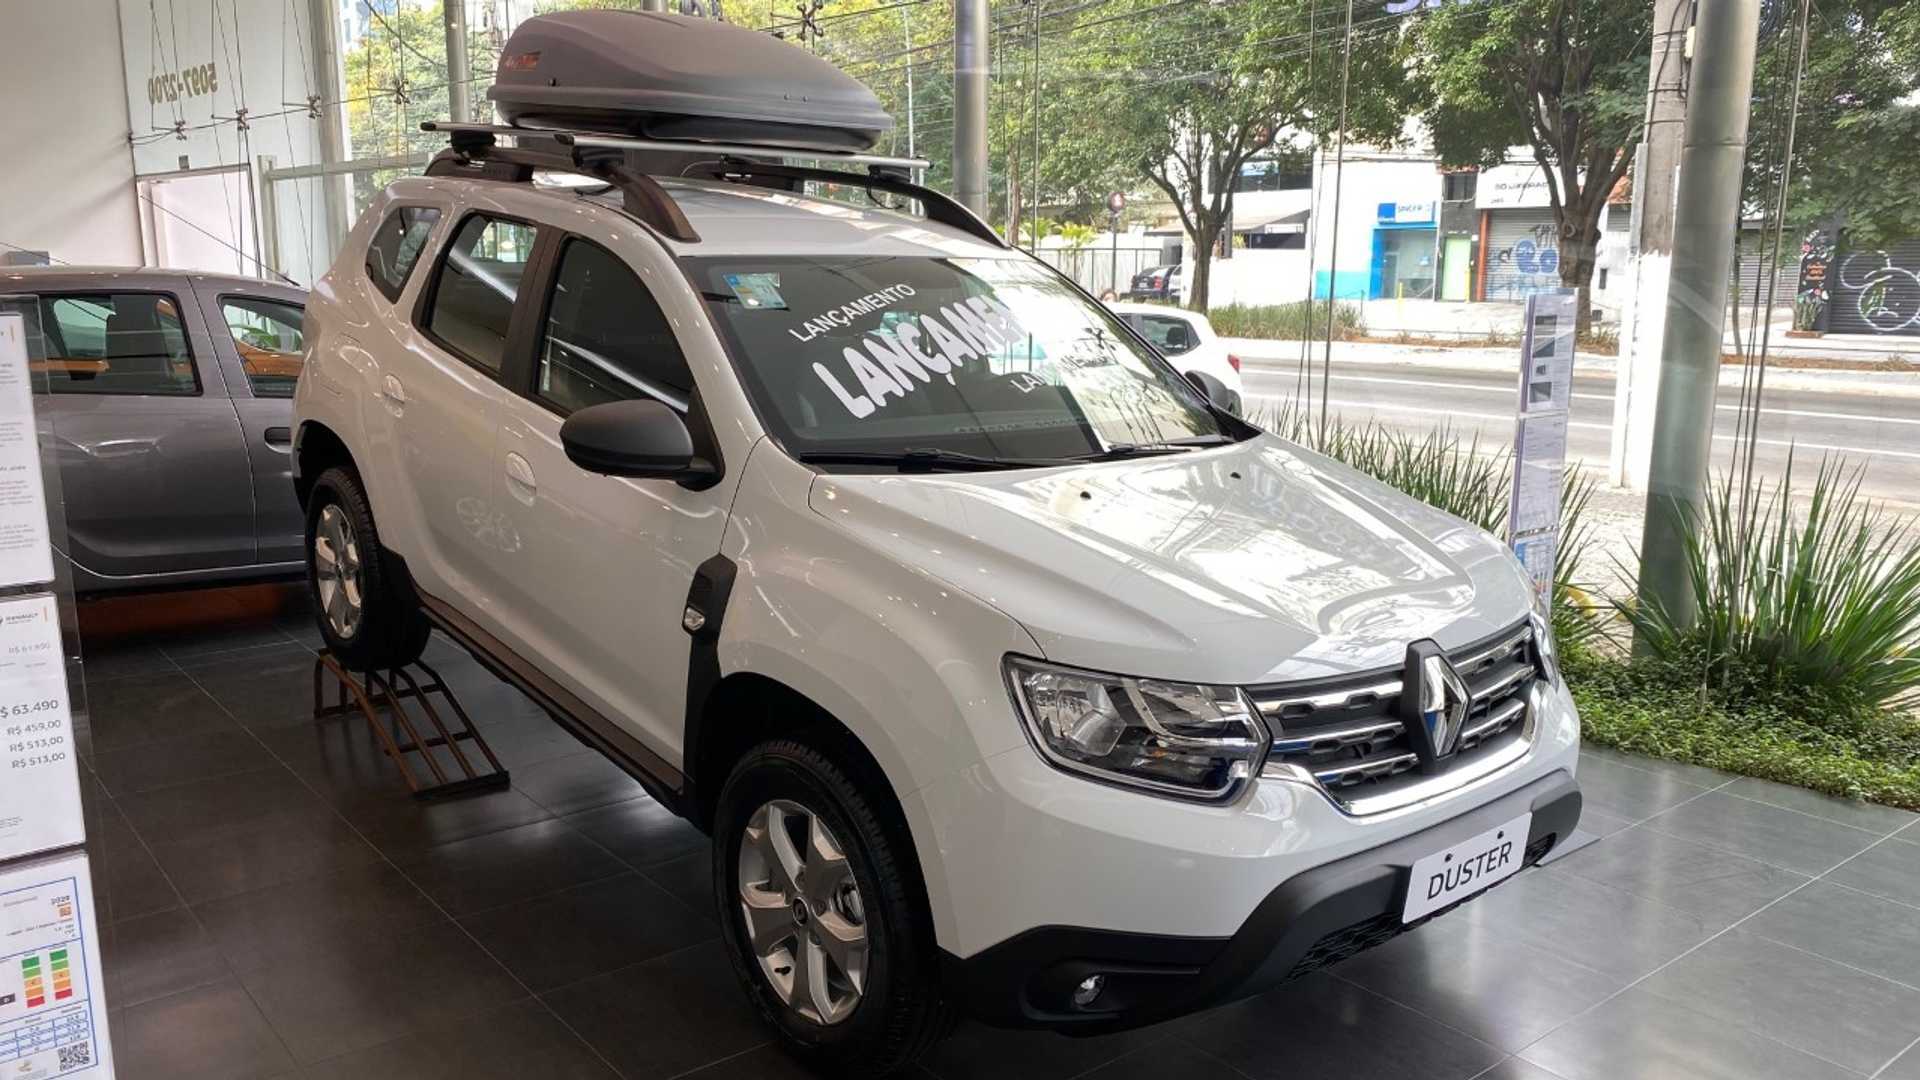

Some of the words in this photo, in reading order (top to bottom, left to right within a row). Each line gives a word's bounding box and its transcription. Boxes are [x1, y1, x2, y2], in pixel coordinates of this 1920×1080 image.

[789, 284, 916, 342] LANÇAMENTO
[12, 699, 59, 716] 63.490
[7, 726, 21, 736] R$
[10, 742, 25, 753] R$
[27, 736, 64, 750] 513,00
[12, 759, 26, 769] R$
[29, 752, 66, 767] 513,00
[1427, 841, 1512, 900] DUSTER
